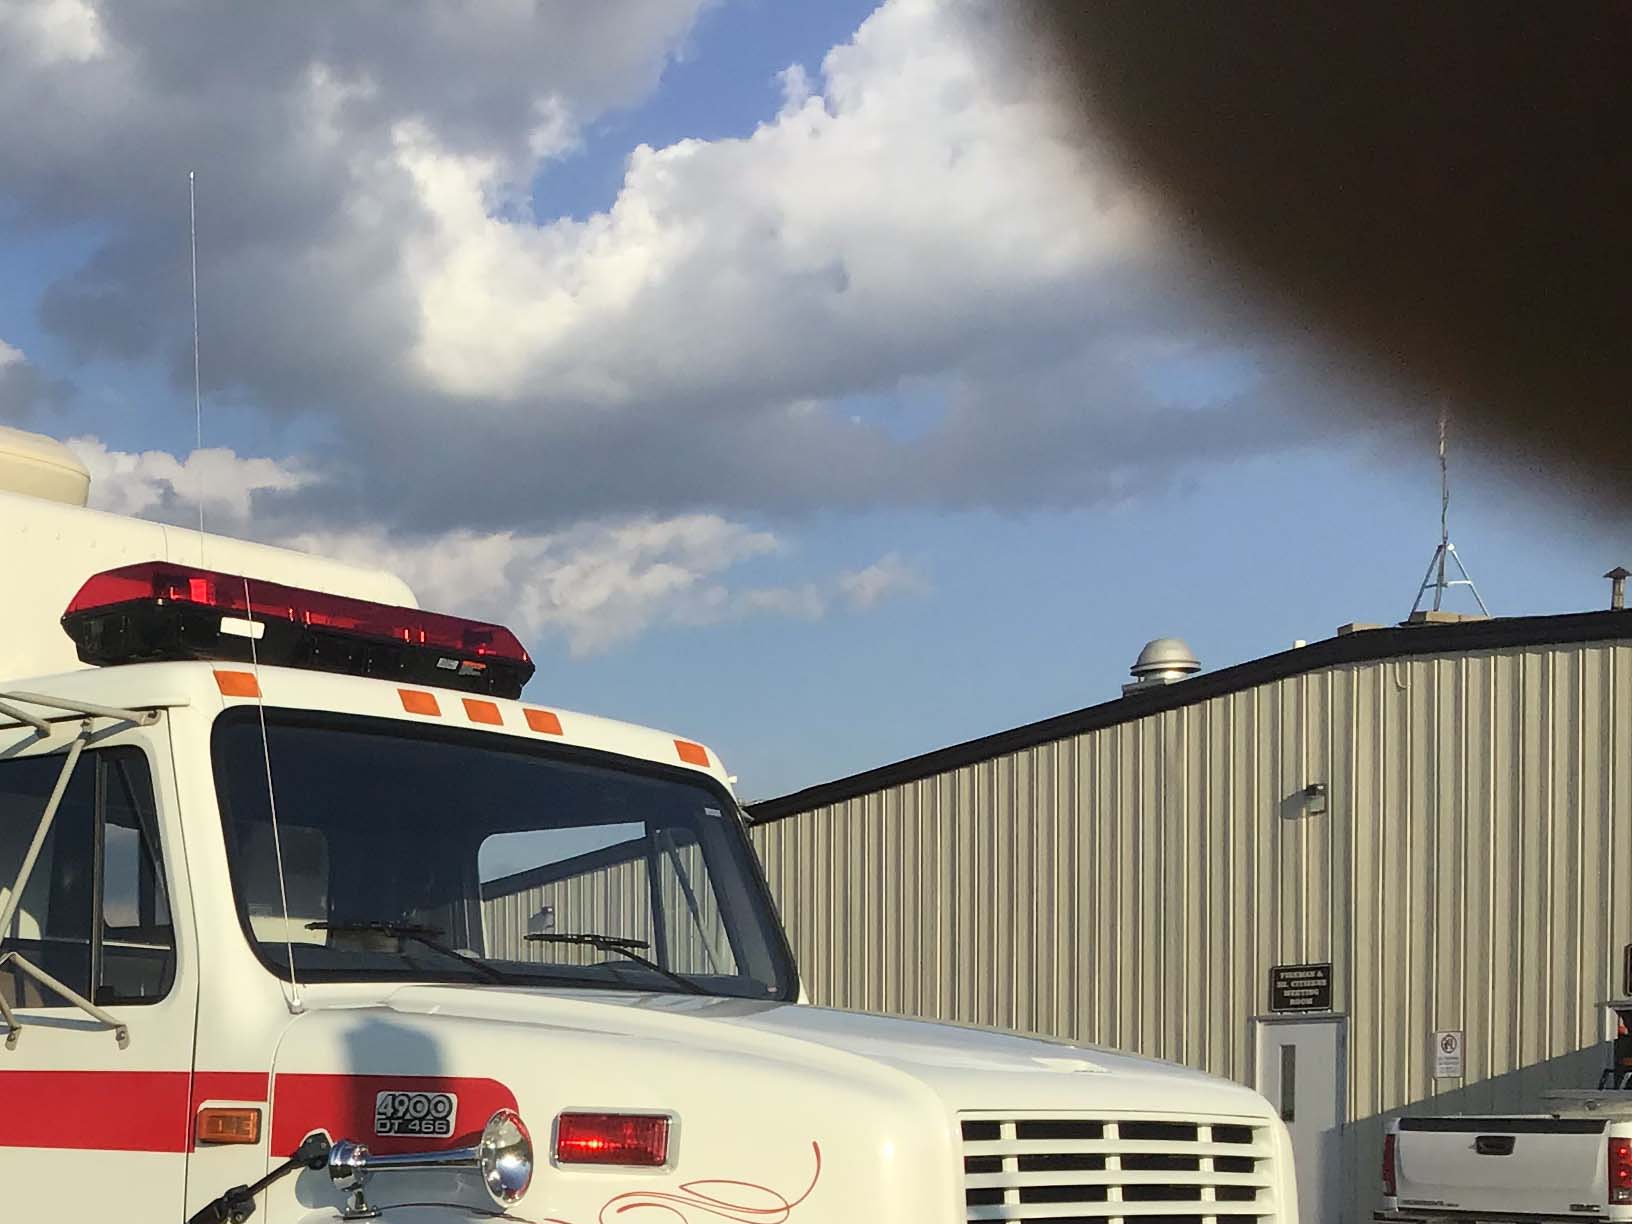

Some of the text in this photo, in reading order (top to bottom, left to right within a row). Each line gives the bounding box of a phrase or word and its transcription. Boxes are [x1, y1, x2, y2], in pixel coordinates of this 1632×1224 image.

[377, 1093, 453, 1119] 4900
[377, 1120, 448, 1133] DT 466
